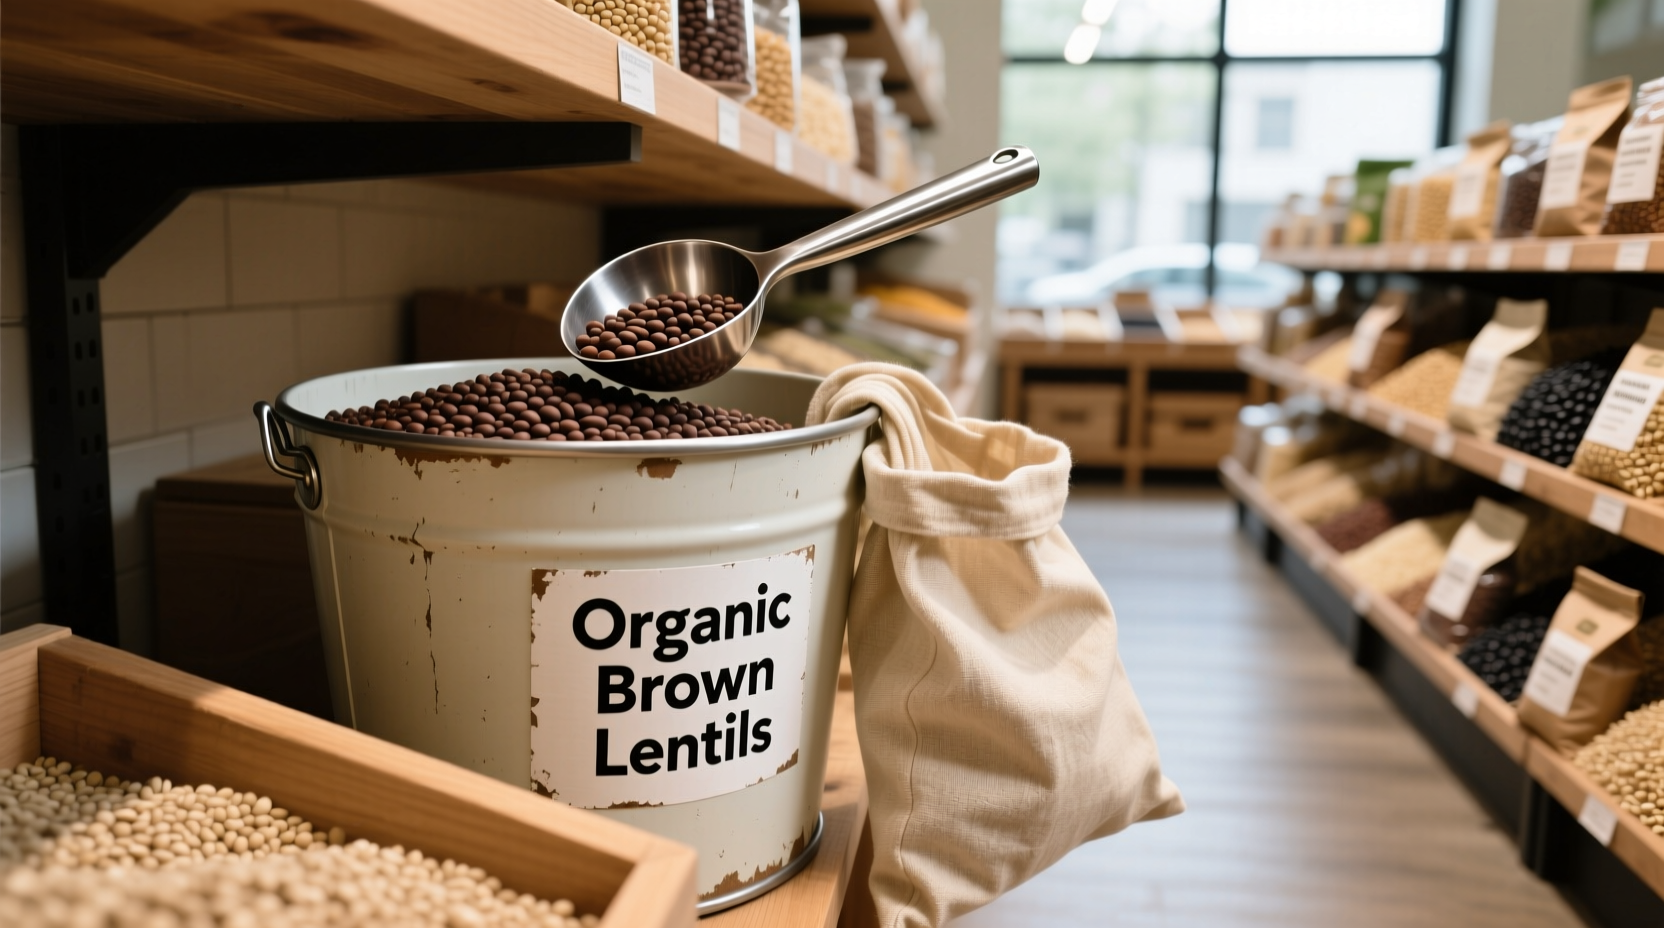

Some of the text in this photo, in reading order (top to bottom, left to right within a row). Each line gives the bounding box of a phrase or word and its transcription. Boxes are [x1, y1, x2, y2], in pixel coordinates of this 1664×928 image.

[572, 582, 792, 663] Organic
[597, 657, 774, 714] Brown
[595, 709, 772, 777] Lentils
